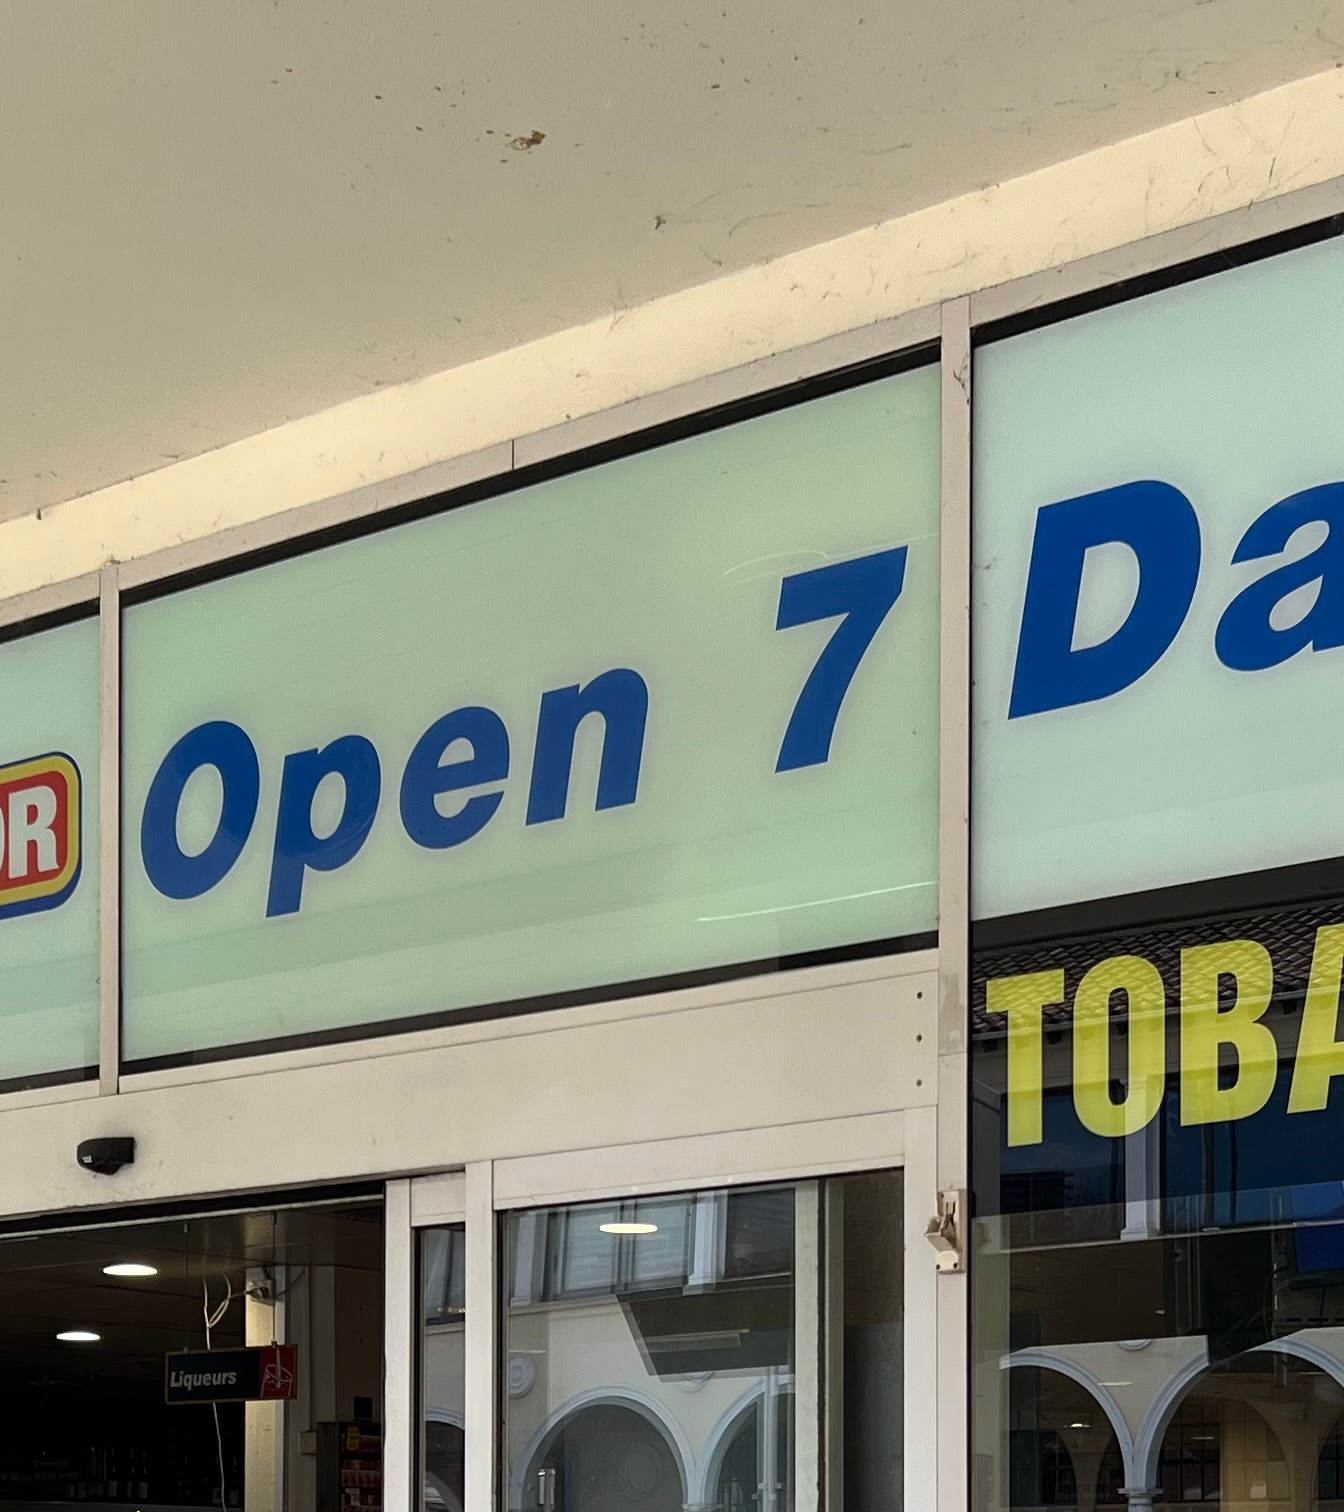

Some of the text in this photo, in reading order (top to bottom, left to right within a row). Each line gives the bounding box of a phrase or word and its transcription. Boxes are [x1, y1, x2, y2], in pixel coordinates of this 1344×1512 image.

[141, 668, 648, 918] Open
[774, 545, 910, 773] 7
[170, 1371, 237, 1391] Liqueurs
